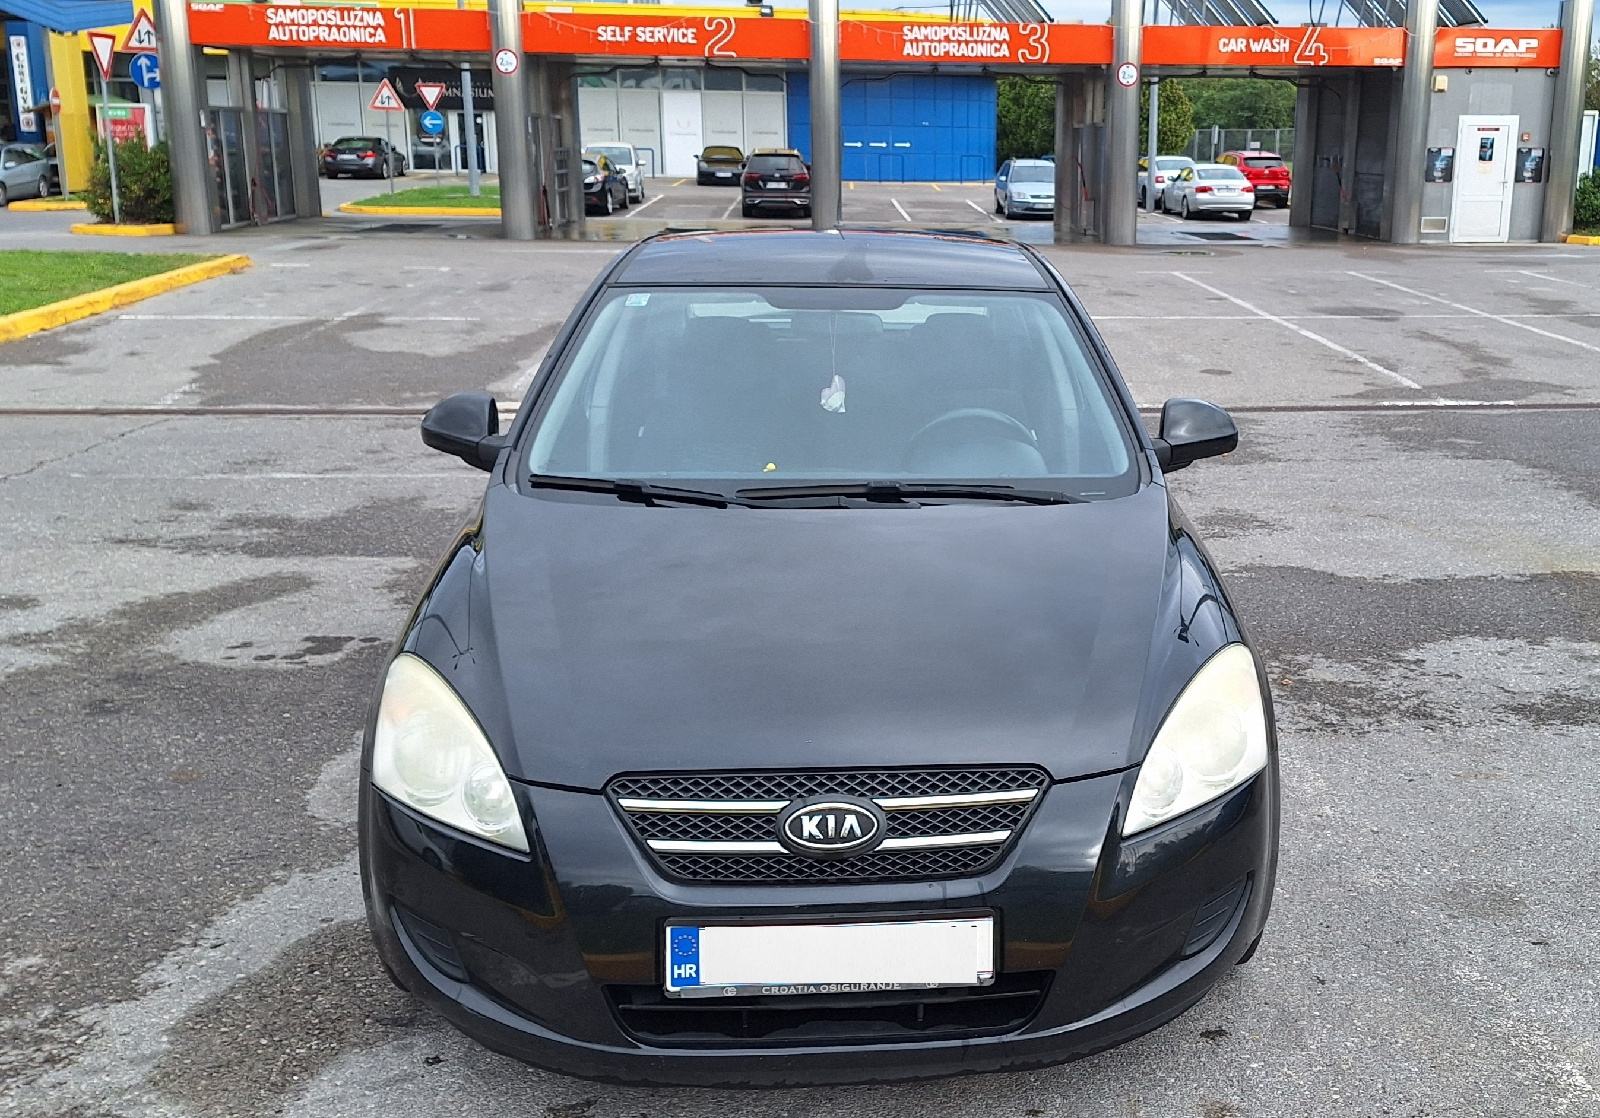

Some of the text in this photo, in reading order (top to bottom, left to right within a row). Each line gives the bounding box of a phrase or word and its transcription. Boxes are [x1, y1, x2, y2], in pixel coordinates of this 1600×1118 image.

[266, 7, 384, 26] SAMOPOSLUŽNA
[268, 26, 386, 43] AUTOPRAONICA
[597, 25, 697, 44] SELF SERVICE
[704, 16, 737, 58] 2
[903, 23, 1010, 41] SAMOPOSLUŽNA
[903, 42, 1010, 58] AUTOPRAONICA
[1018, 22, 1050, 64] 3
[1218, 38, 1290, 53] CAR WASH
[1293, 26, 1329, 66] 4
[1454, 37, 1539, 53] SOAP
[800, 814, 863, 840] KIA
[673, 963, 697, 979] HR
[761, 982, 901, 995] CROATIA OSIGURANJE
